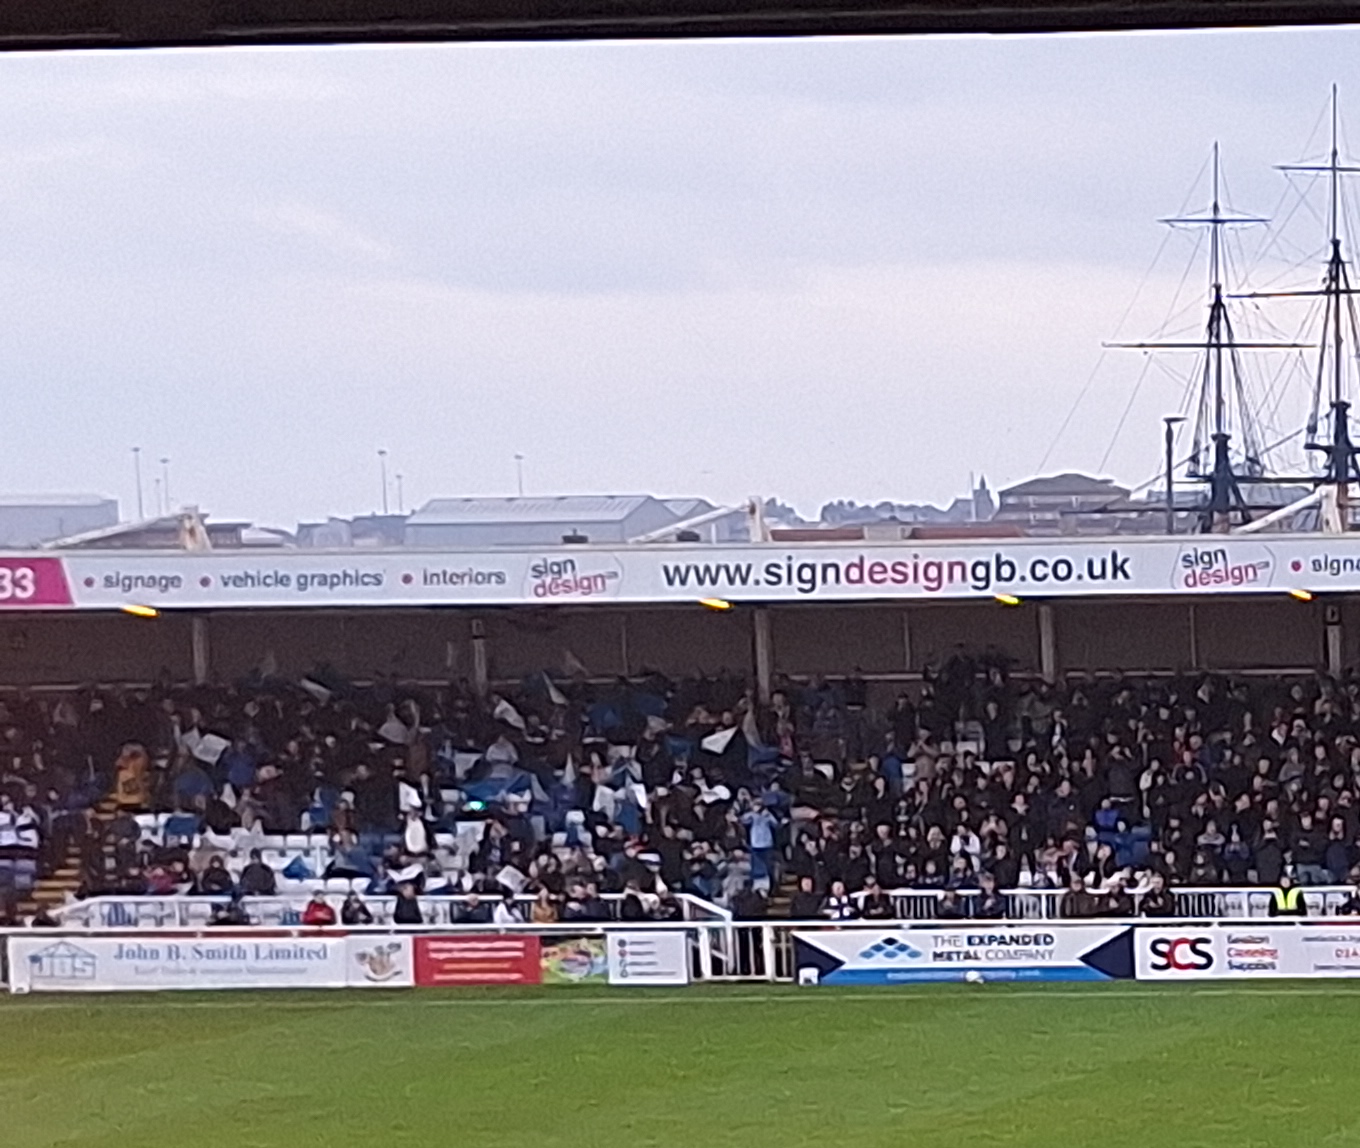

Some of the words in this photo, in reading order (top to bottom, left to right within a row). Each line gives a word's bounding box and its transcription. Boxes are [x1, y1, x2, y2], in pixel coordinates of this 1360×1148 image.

[530, 556, 576, 579] sign
[1182, 547, 1227, 570] sign
[103, 571, 182, 592] signage
[221, 570, 290, 588] vehicle
[297, 570, 384, 592] graphics
[423, 567, 507, 586] interiors
[663, 550, 1132, 593] www.signdesigngb.co.uk
[1184, 563, 1257, 589] design
[533, 573, 606, 598] design
[114, 943, 160, 961] John
[193, 943, 247, 961] Smith
[254, 943, 328, 961] Limited
[932, 935, 962, 947] THE
[967, 933, 1055, 947] EXPANDED
[932, 950, 981, 962] METAL
[985, 949, 1055, 961] COMPANY
[1150, 937, 1214, 971] SCS
